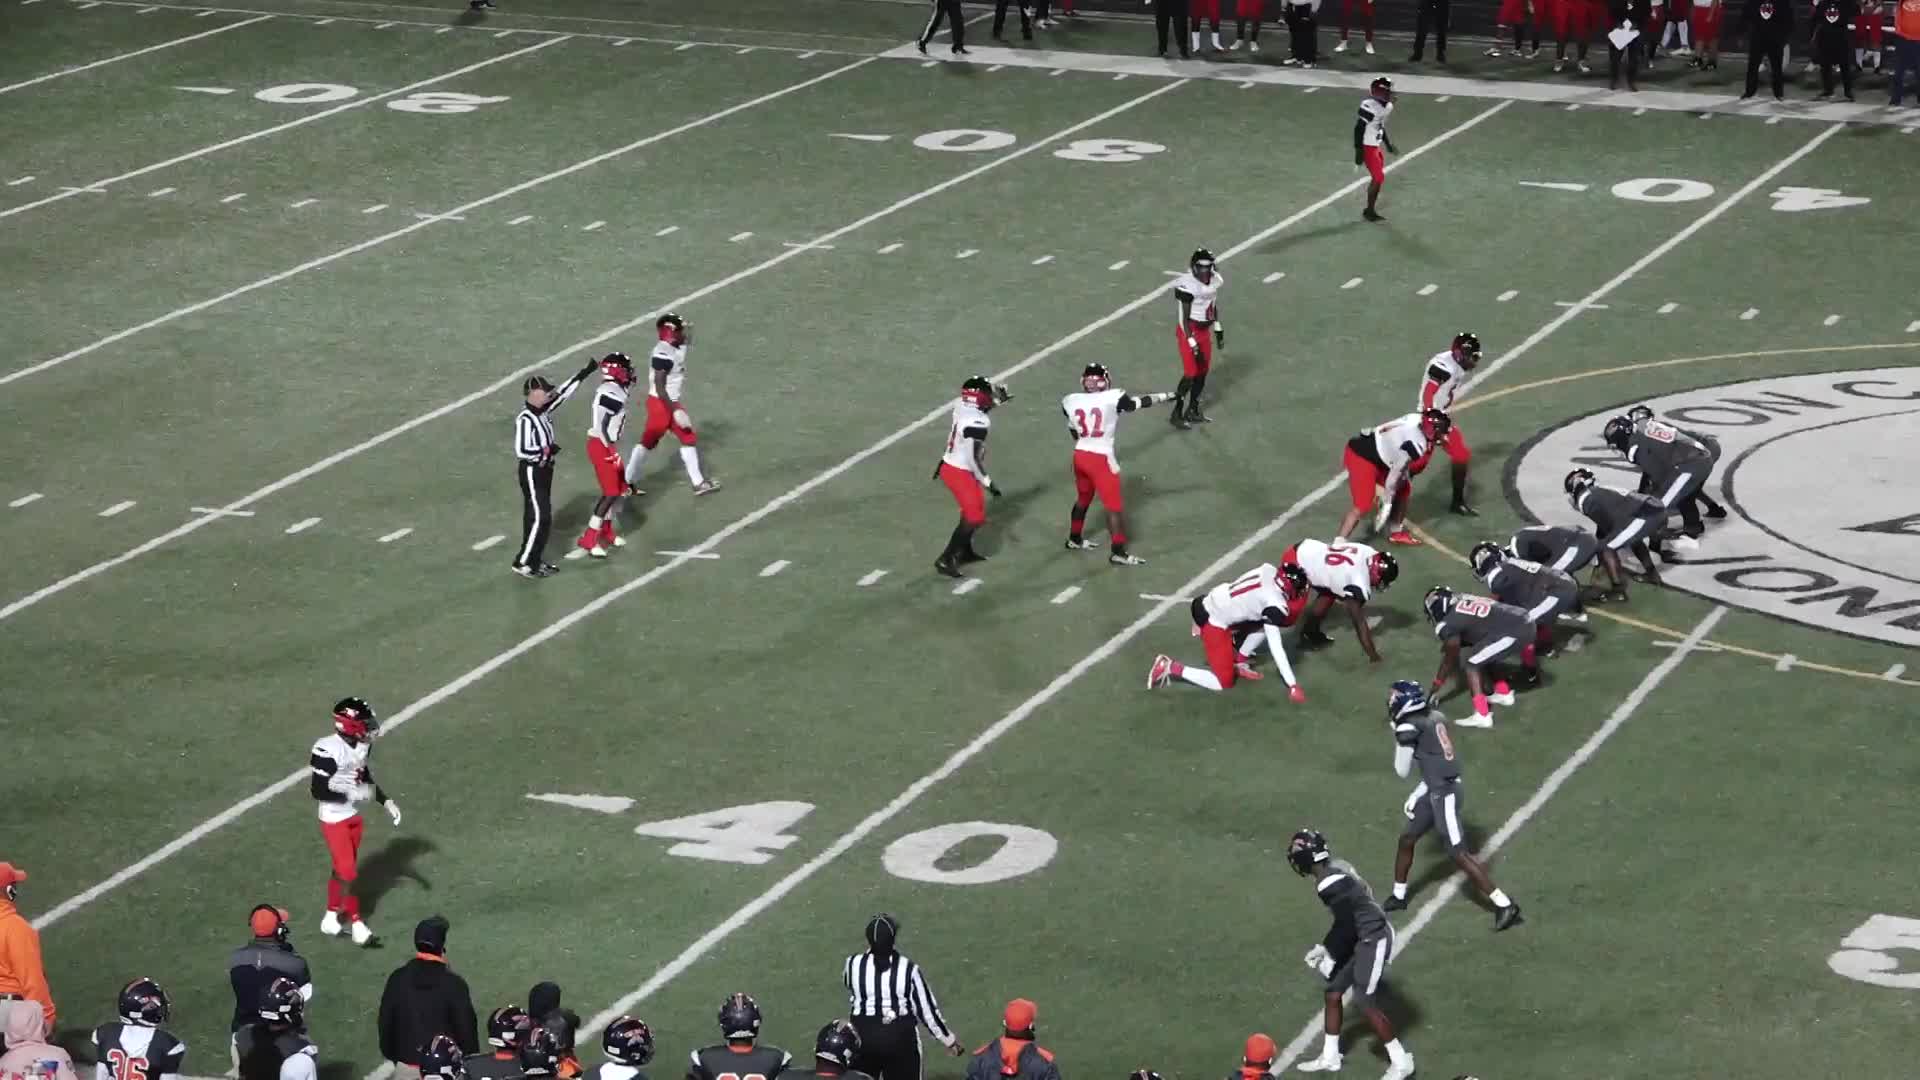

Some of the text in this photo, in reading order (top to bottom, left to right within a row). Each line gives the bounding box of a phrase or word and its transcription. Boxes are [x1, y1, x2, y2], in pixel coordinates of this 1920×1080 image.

[1074, 407, 1104, 438] 32
[1229, 574, 1263, 599] 11
[635, 800, 1059, 884] 40
